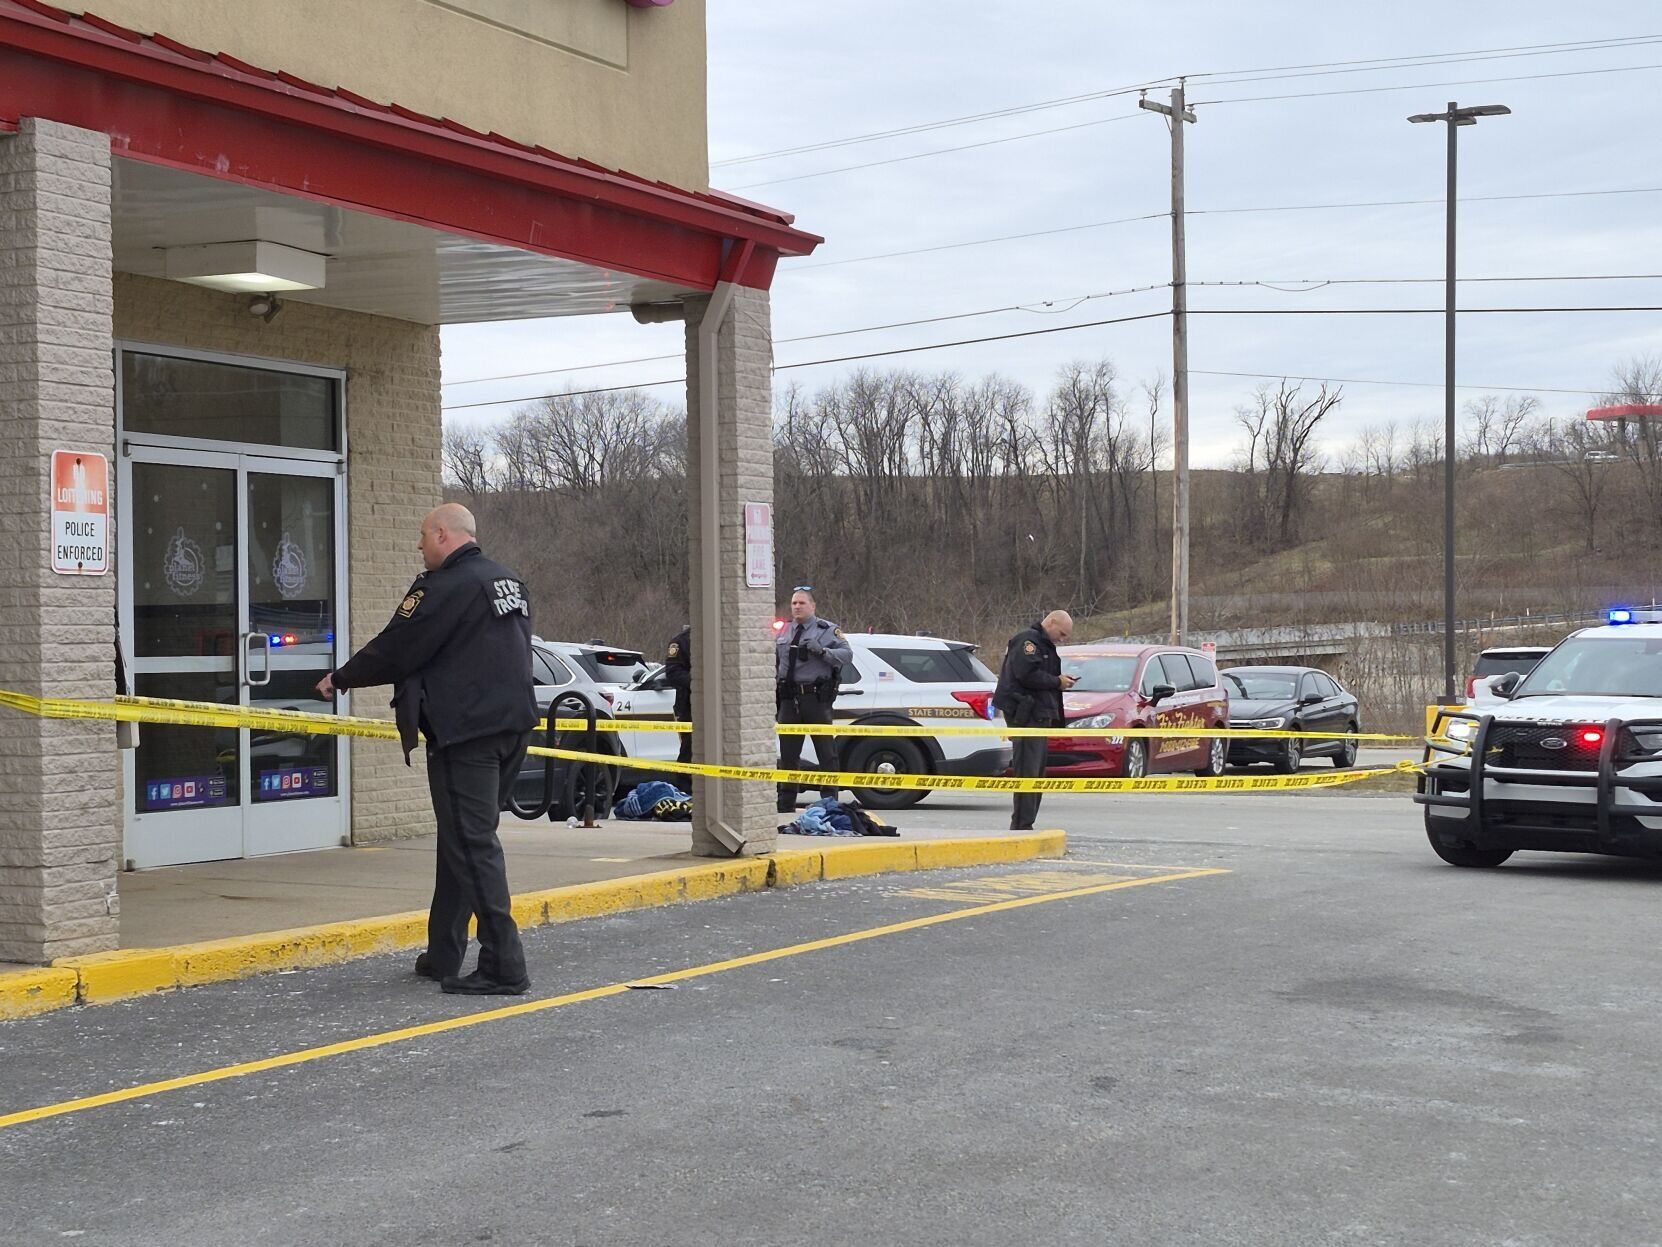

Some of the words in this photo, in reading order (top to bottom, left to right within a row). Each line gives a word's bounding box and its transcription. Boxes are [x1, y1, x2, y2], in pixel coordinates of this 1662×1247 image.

[65, 521, 95, 537] POLICE
[57, 544, 103, 561] ENFORCED
[616, 700, 631, 711] 24
[908, 708, 932, 717] STATE
[935, 708, 975, 718] TROOPER
